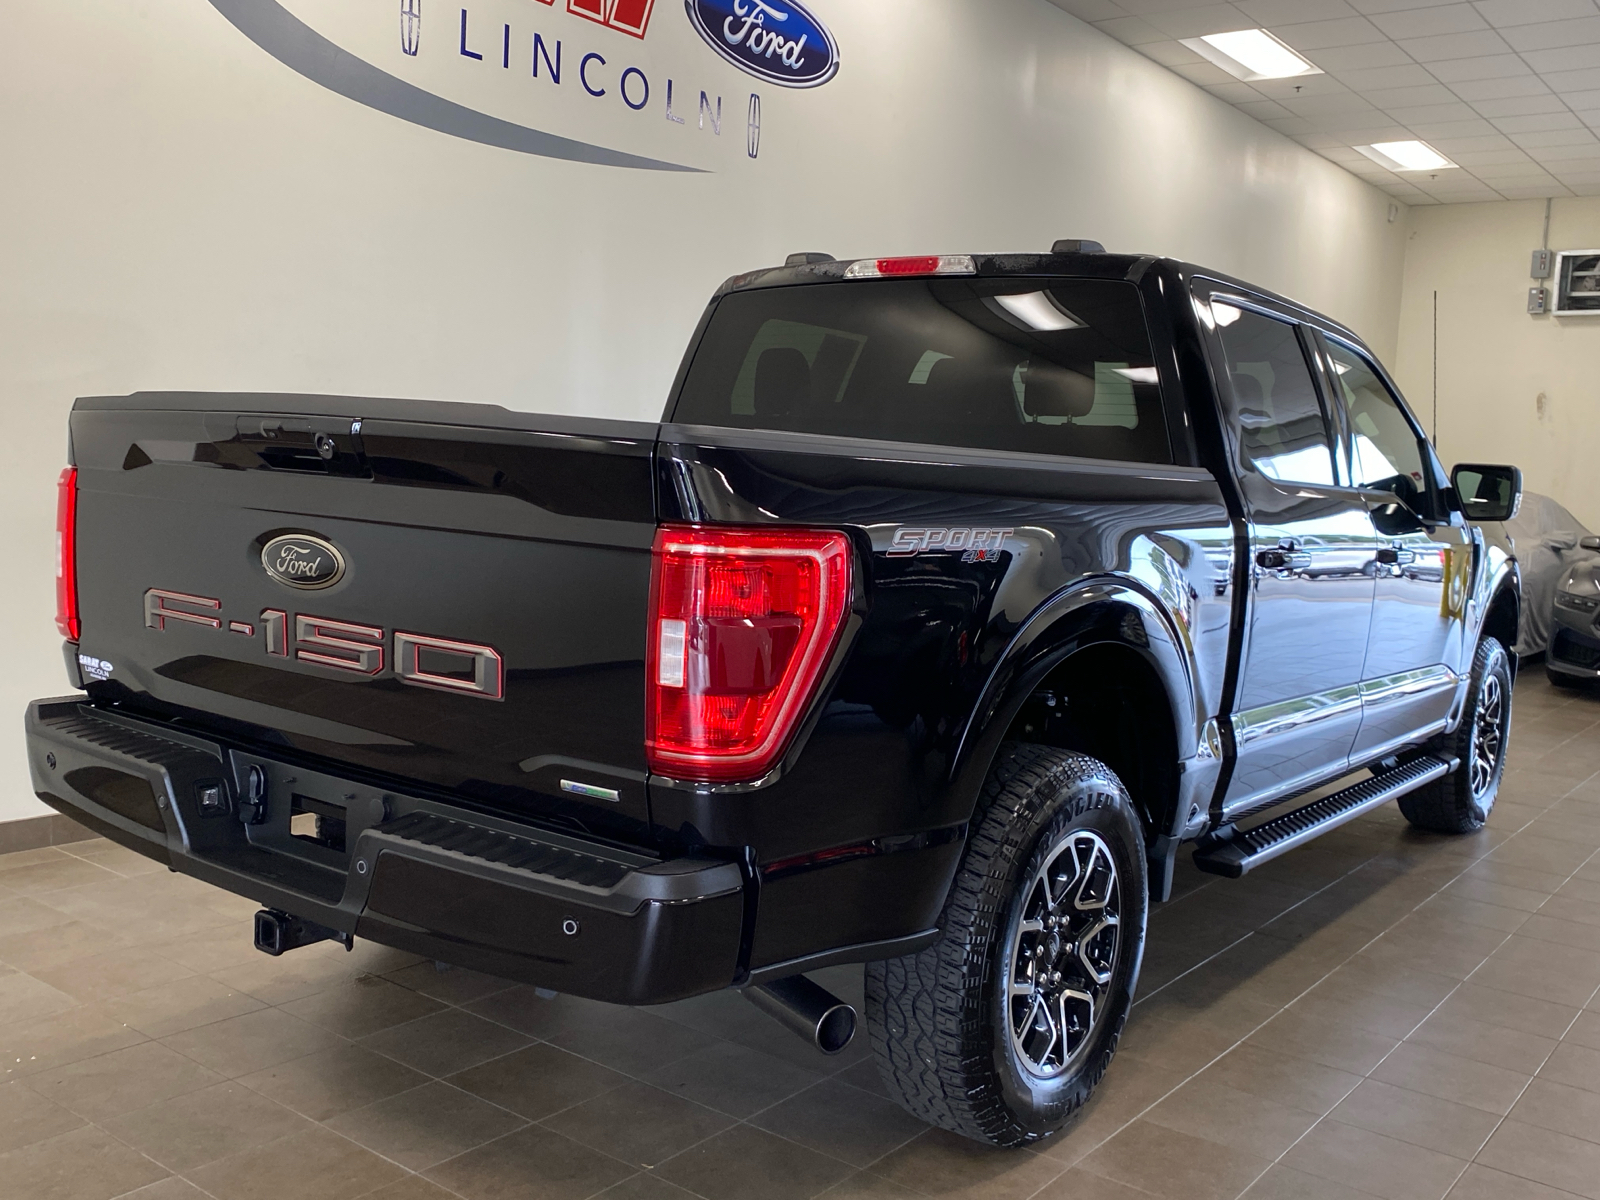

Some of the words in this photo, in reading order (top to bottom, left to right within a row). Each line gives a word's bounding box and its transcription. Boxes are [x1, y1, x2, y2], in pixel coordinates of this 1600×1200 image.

[723, 0, 806, 69] Ford
[460, 9, 722, 135] LINCOLN
[277, 543, 321, 578] Ford
[886, 527, 1014, 558] SPORT
[144, 587, 505, 700] F-150
